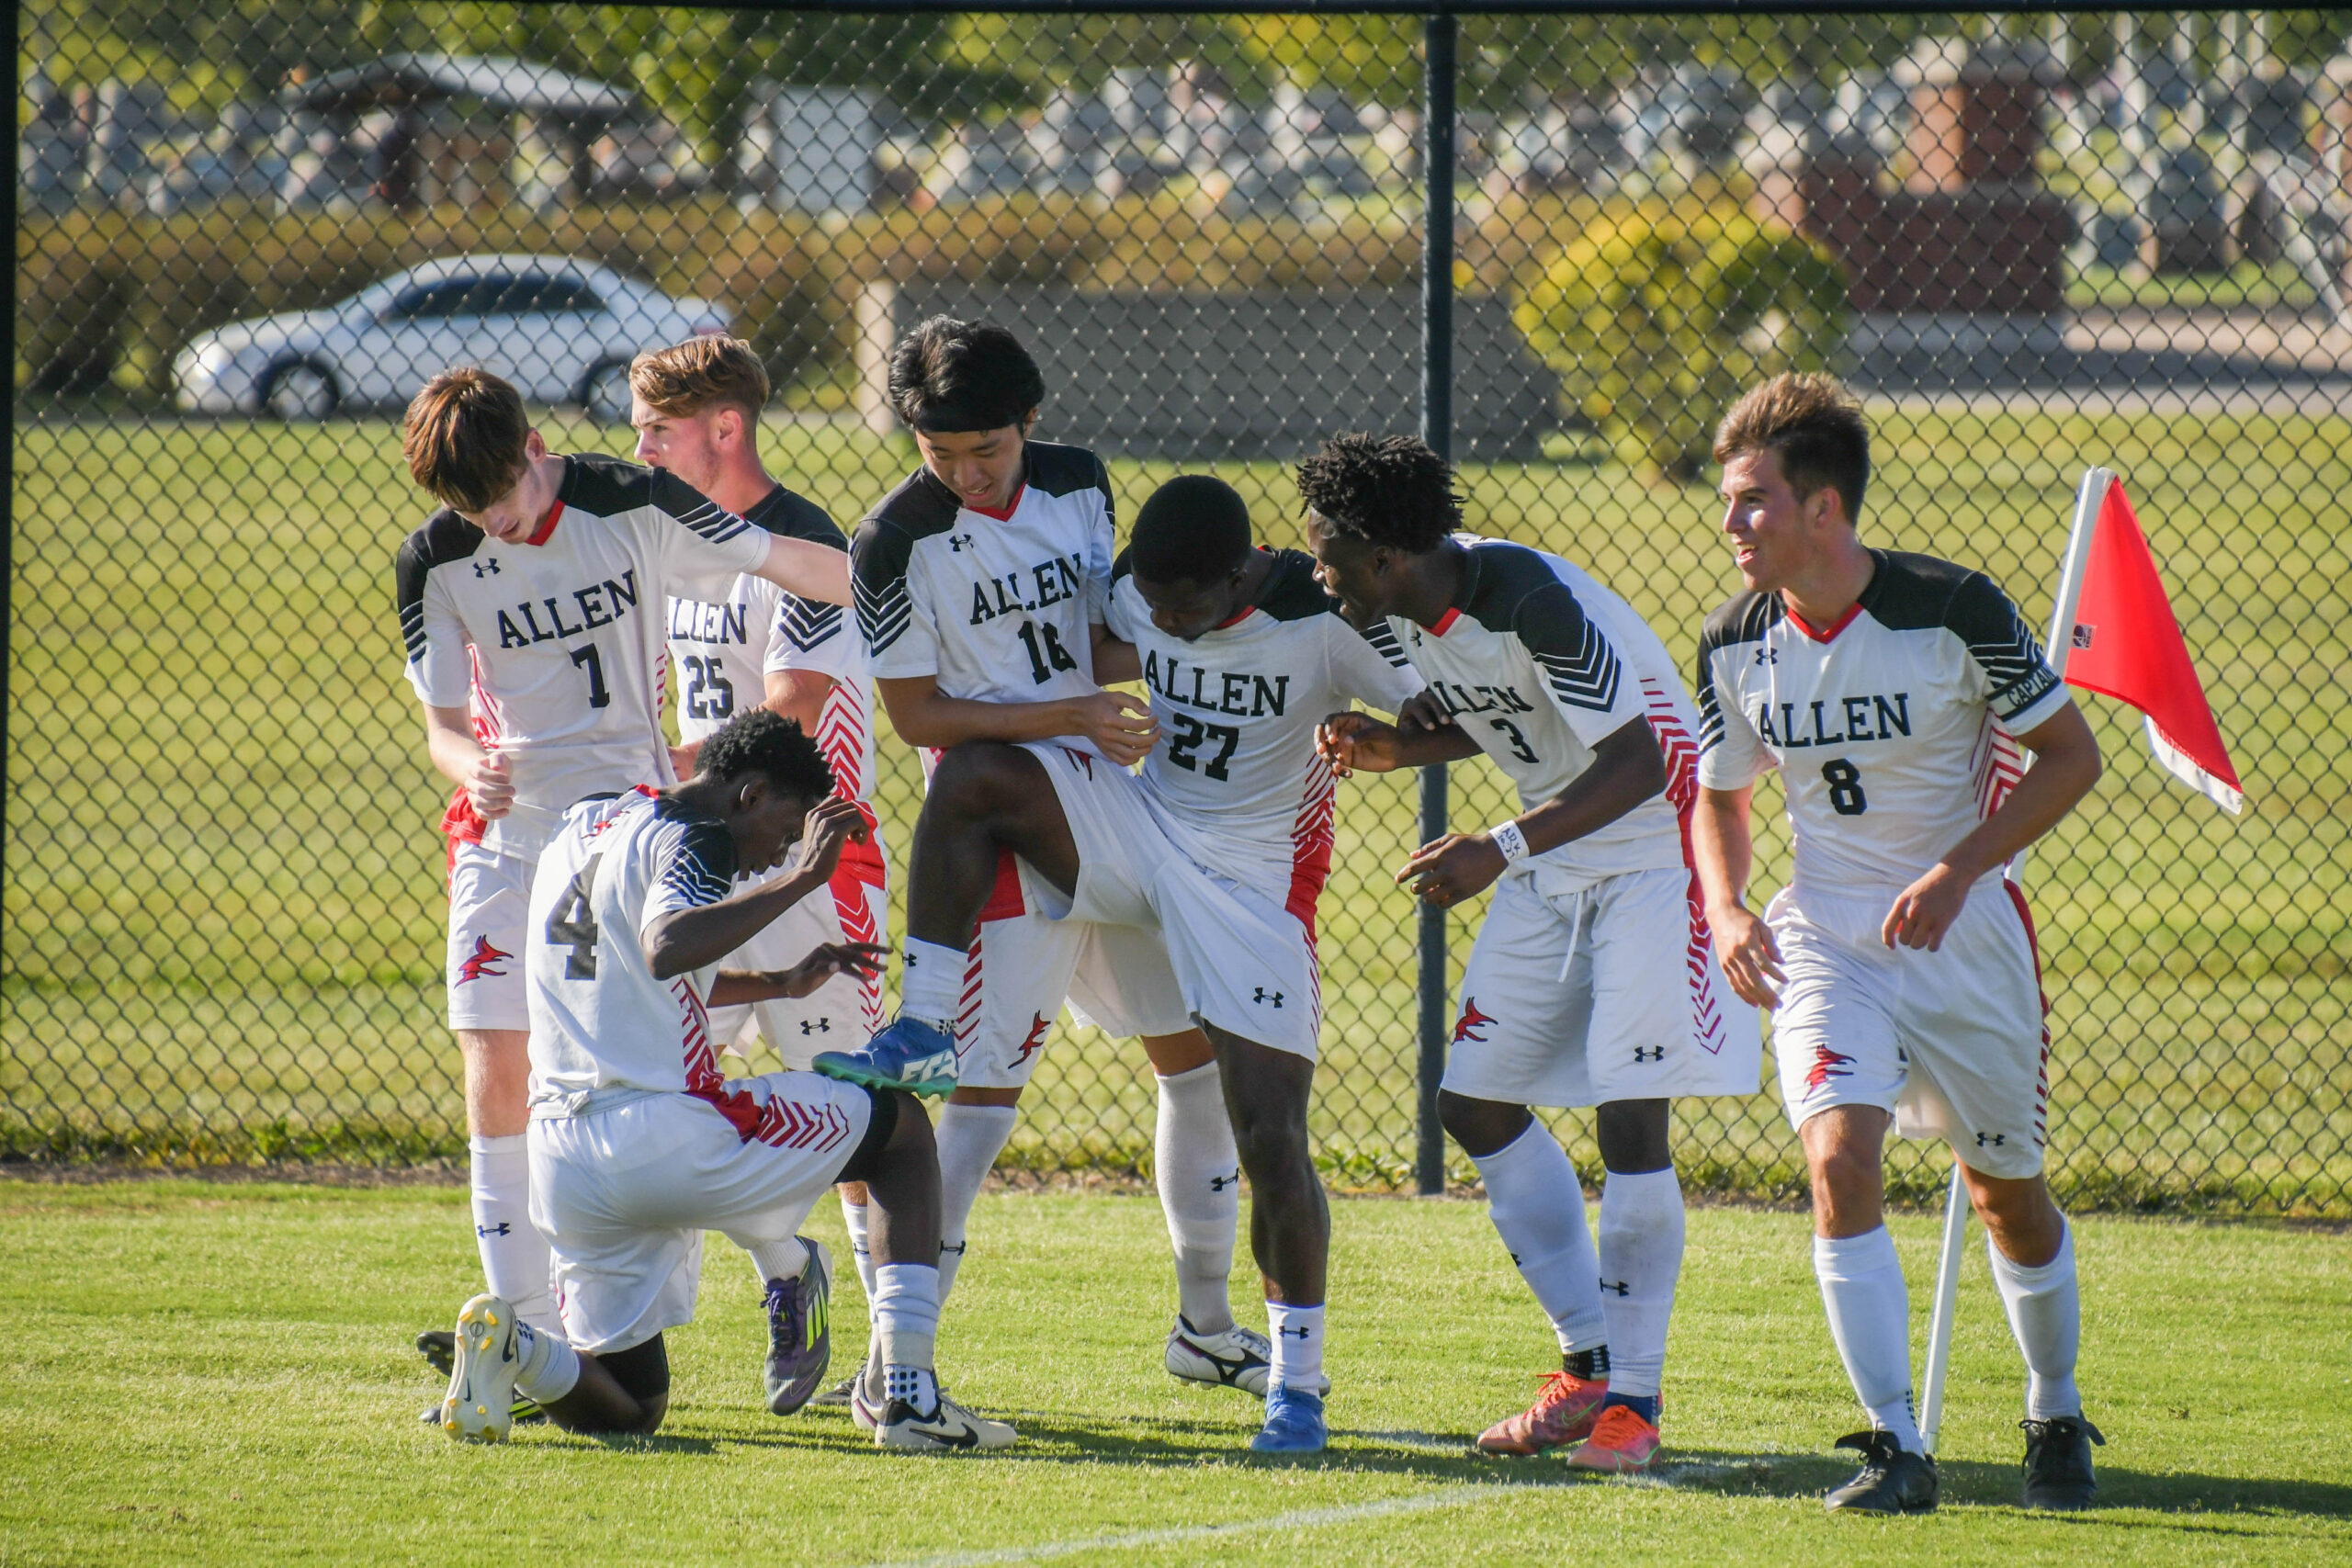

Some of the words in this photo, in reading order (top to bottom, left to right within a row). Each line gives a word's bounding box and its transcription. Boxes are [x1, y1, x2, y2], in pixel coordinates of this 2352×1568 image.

[497, 570, 637, 649] ALLEN
[668, 598, 747, 644] LLEN
[969, 553, 1080, 626] ALLEN
[569, 643, 610, 707] 7
[683, 655, 734, 719] 25
[1145, 649, 1289, 716] ALLEN
[1432, 681, 1534, 716] LLEN
[1169, 712, 1239, 782] 27
[1490, 718, 1540, 763] 3
[1759, 693, 1912, 748] ALLEN
[1821, 758, 1867, 816] 8
[545, 852, 603, 981] 4
